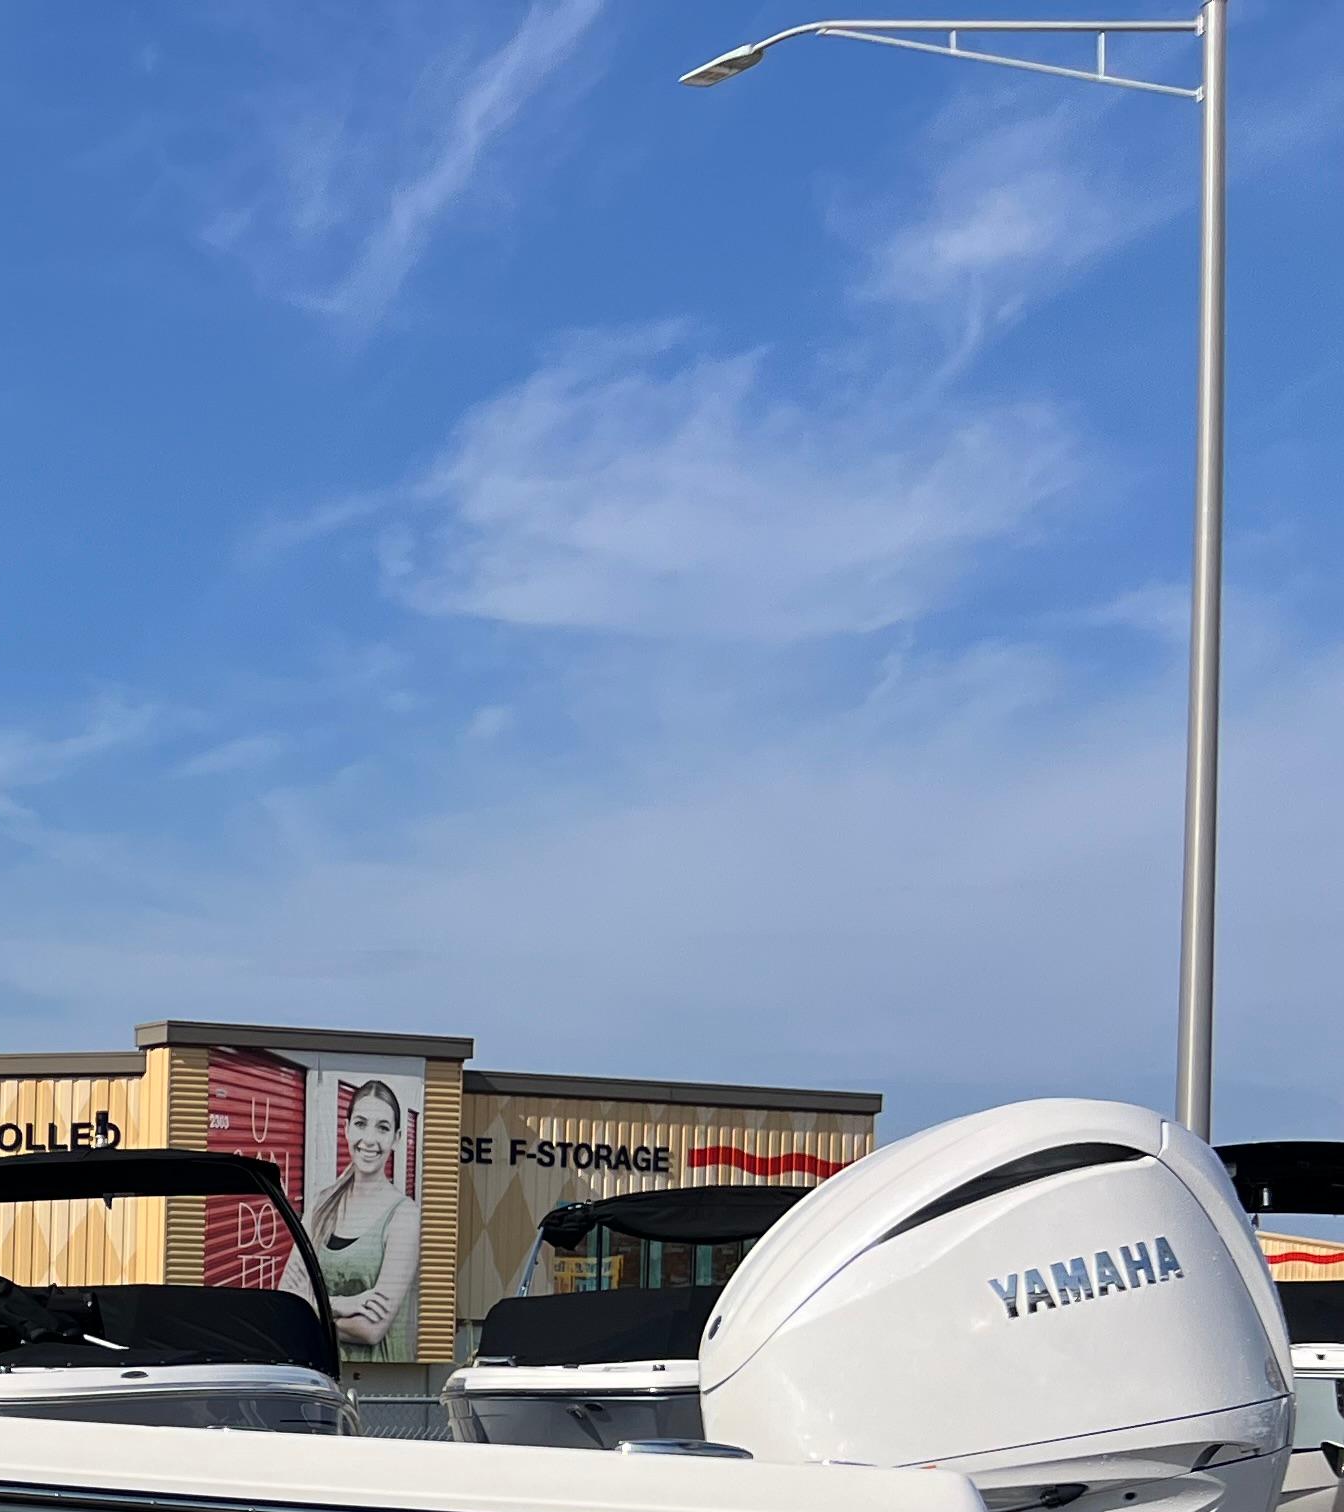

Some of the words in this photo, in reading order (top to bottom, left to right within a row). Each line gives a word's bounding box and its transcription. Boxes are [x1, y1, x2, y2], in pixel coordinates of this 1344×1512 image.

[251, 1096, 270, 1143] U
[237, 1201, 277, 1249] DO
[987, 1235, 1185, 1319] YAMAHA
